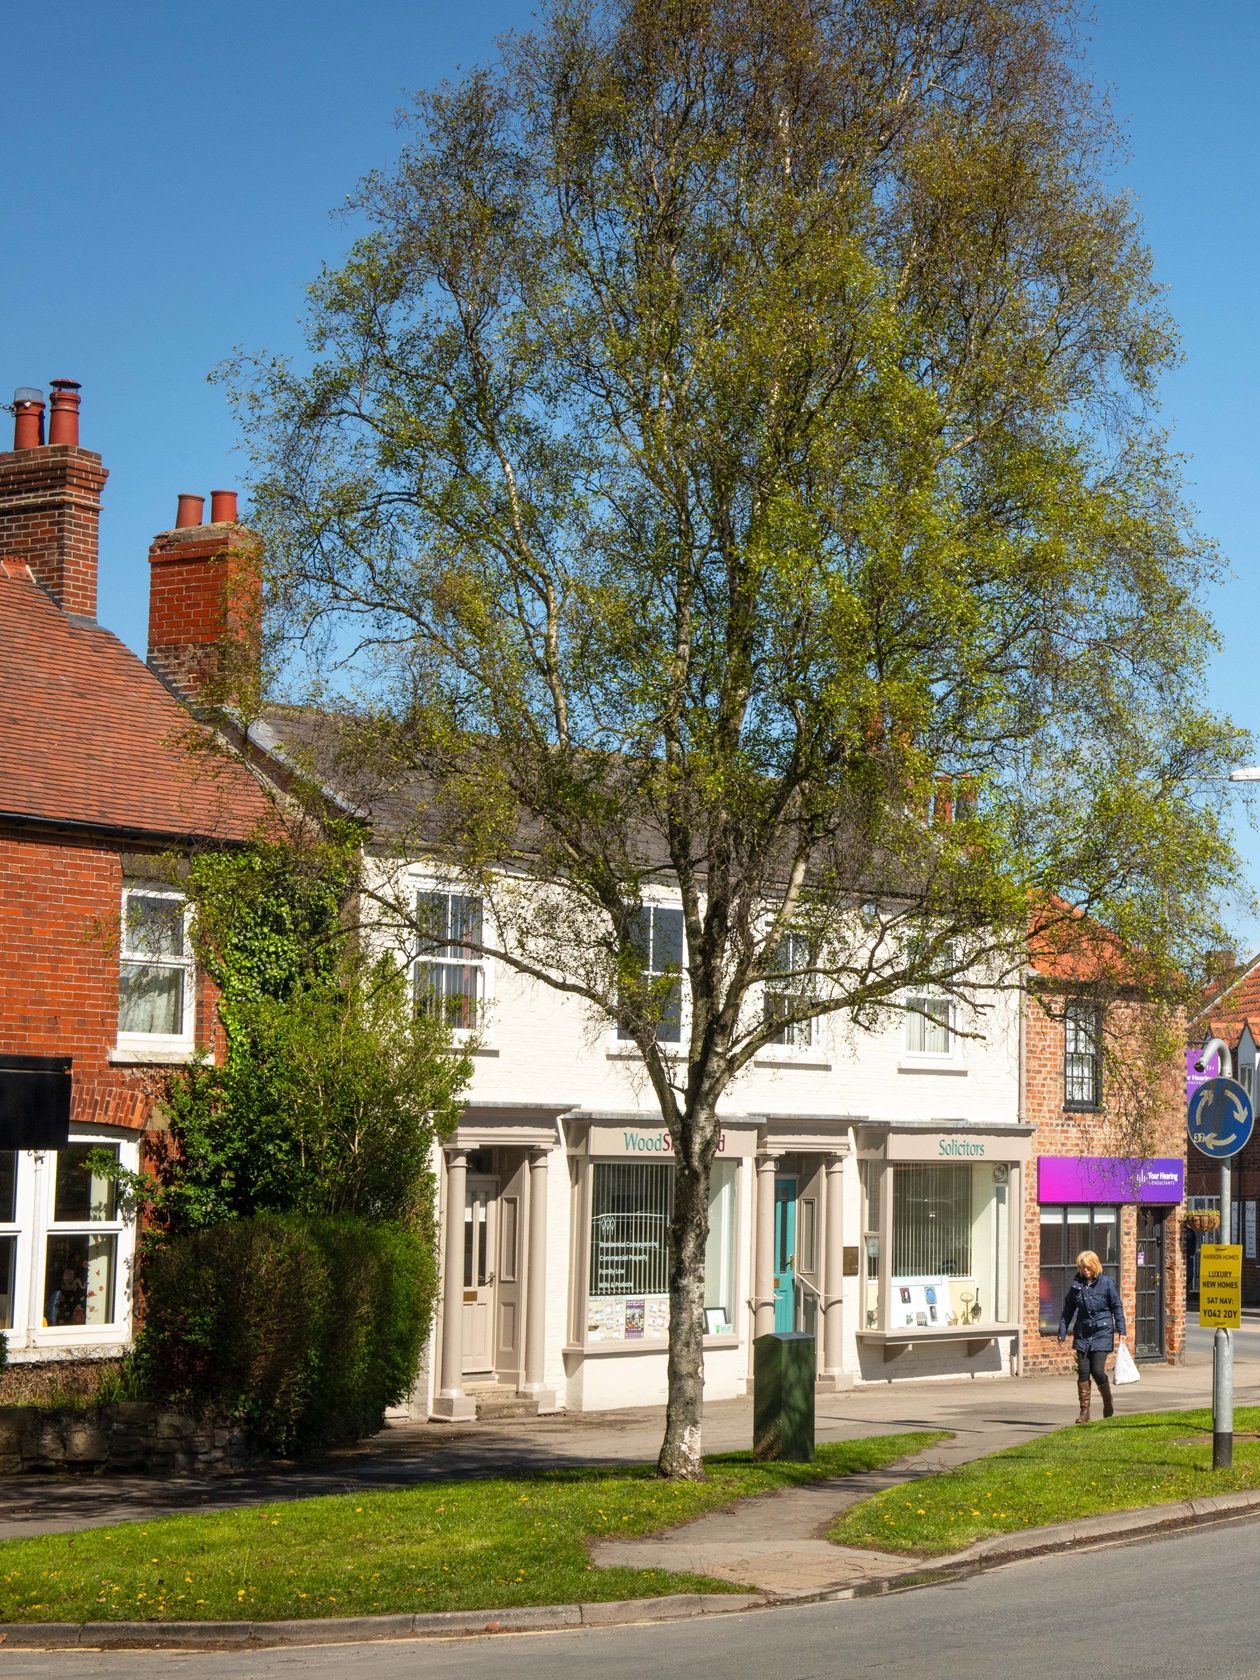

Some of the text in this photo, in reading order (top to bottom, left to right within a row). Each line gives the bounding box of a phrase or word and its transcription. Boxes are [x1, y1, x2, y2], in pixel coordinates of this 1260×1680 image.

[939, 1139, 985, 1156] Solicitors
[1148, 1172, 1178, 1182] Your Hearing
[1220, 1297, 1234, 1305] NAV:
[1223, 1310, 1238, 1318] 2DY
